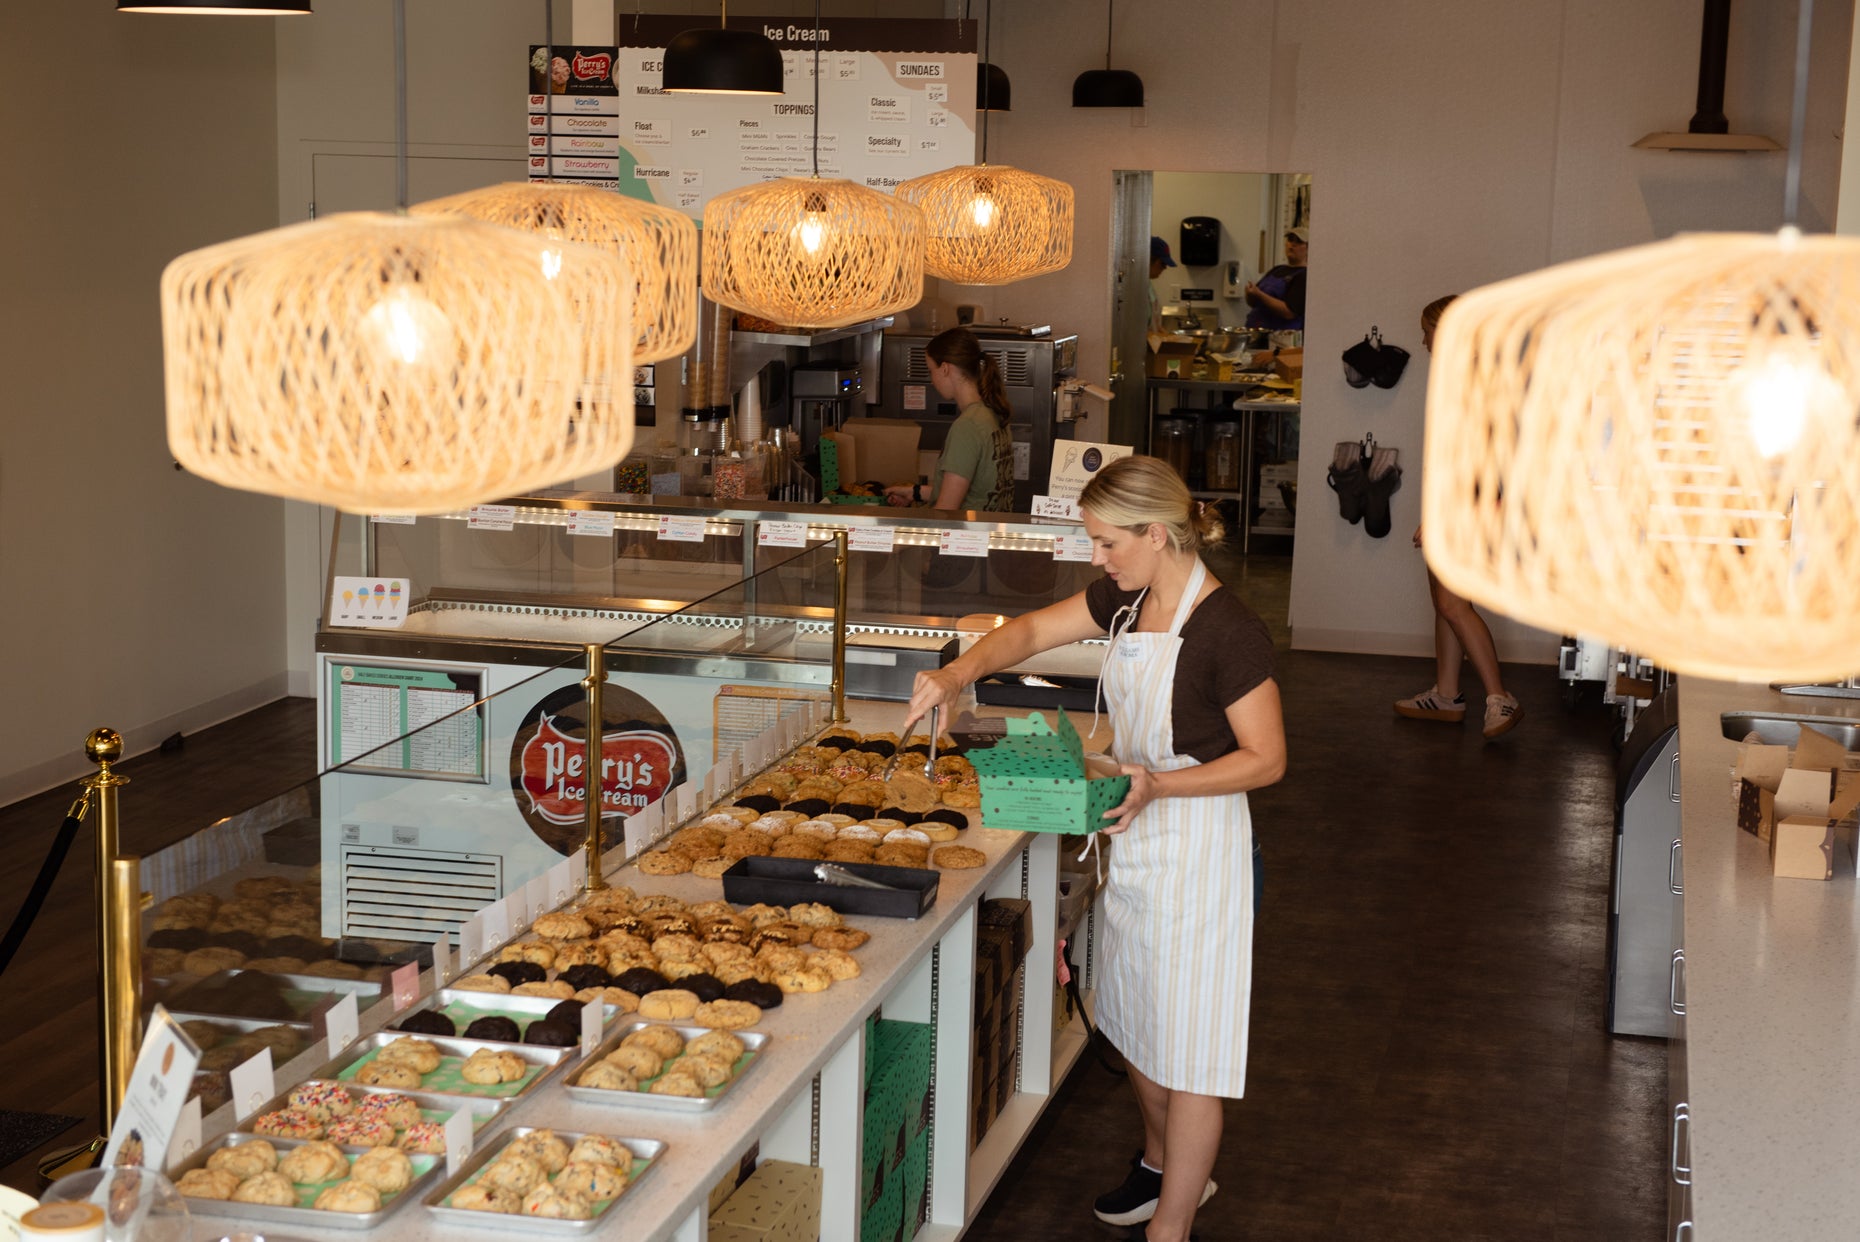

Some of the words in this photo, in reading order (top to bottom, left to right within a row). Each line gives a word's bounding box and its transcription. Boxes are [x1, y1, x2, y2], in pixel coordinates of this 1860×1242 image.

[763, 24, 784, 40] Ice
[786, 24, 830, 41] Cream
[577, 58, 606, 72] Perry's
[641, 61, 655, 72] ICE
[900, 64, 940, 76] SUNDAES
[574, 98, 600, 106] Vanilla
[870, 97, 897, 107] Classic
[773, 104, 815, 115] TOPPINGS
[566, 118, 608, 127] Chocolate
[634, 121, 653, 131] Float
[739, 120, 759, 128] Pieces
[570, 139, 605, 148] Rainbow
[867, 136, 902, 148] Specialty
[564, 159, 610, 170] Strawberry
[635, 167, 670, 178] Hurricane
[866, 177, 906, 187] Half-Bake
[541, 741, 654, 791] Pery's
[557, 776, 586, 801] Ice
[600, 786, 648, 807] ream
